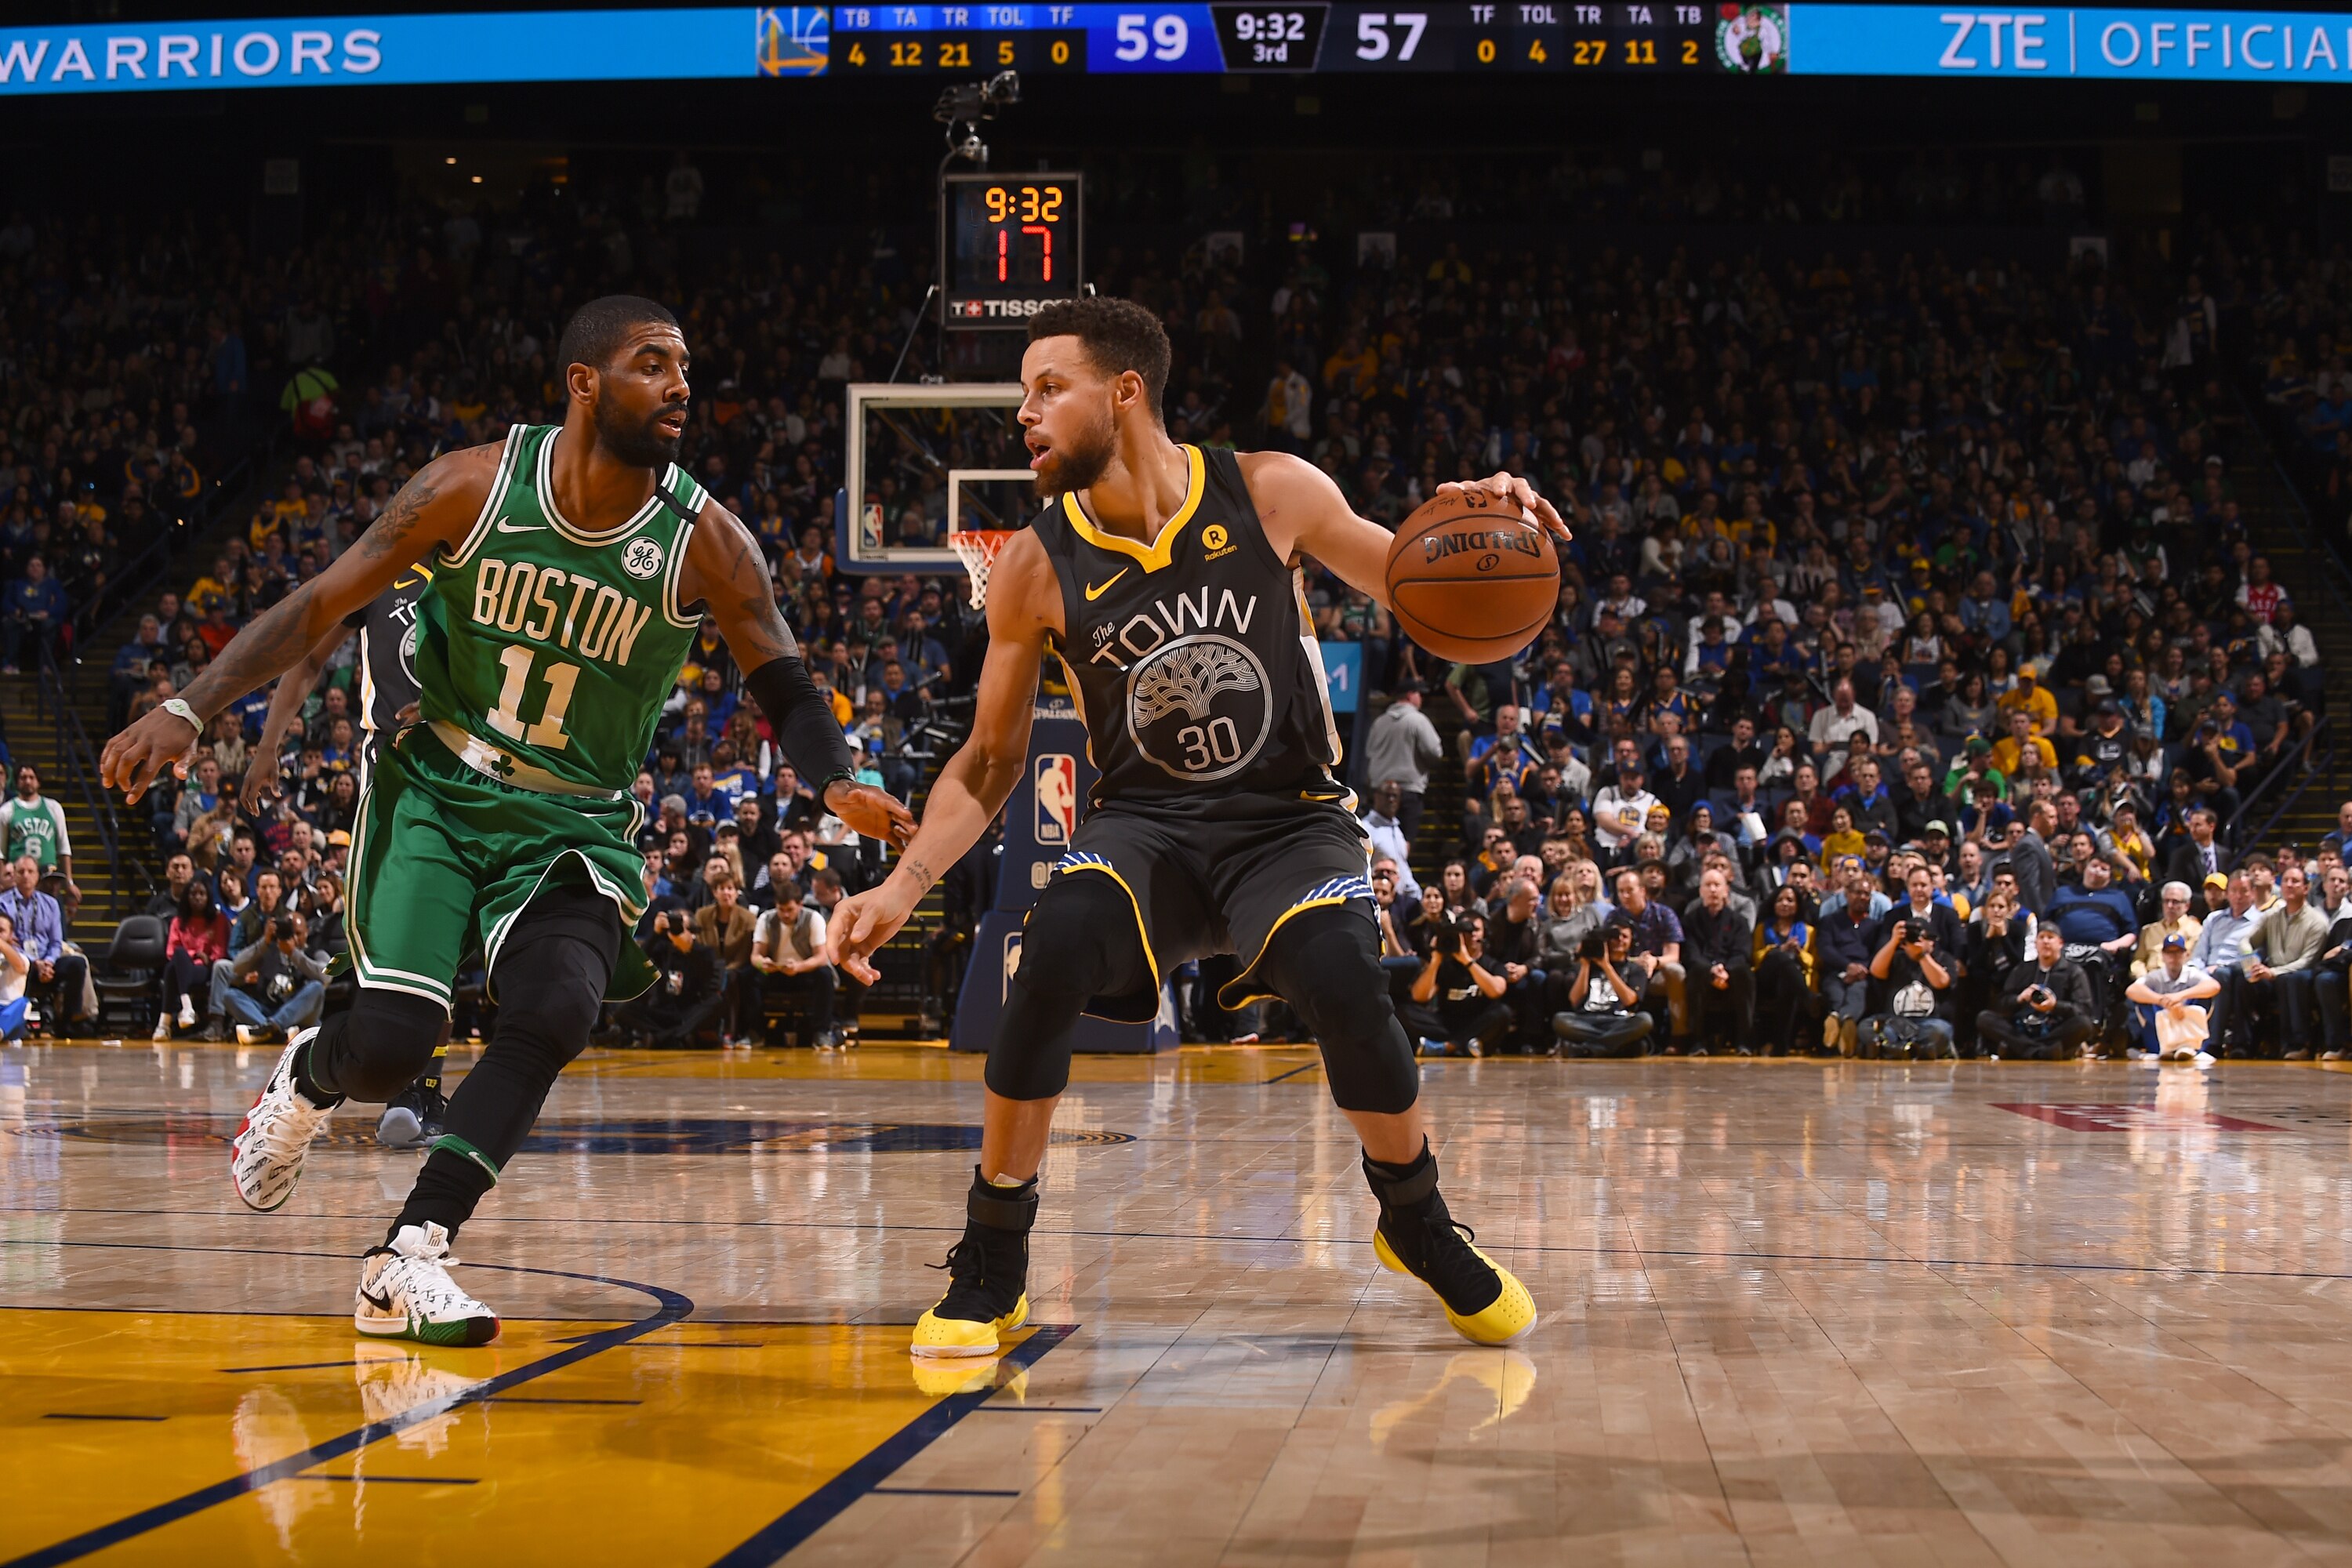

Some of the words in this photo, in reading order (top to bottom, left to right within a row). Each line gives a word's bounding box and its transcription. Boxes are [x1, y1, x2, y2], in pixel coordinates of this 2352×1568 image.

[845, 9, 869, 27] TB
[895, 8, 918, 27] TA
[943, 8, 969, 26] TR
[989, 7, 1023, 26] TOL
[1051, 6, 1073, 24] TF
[1236, 13, 1305, 41] 9:32
[1471, 5, 1495, 24] TF
[1520, 5, 1556, 24] TOL
[1575, 5, 1602, 24] TR
[1627, 5, 1653, 24] TA
[1675, 5, 1702, 24] TB
[848, 42, 866, 66] 4
[890, 42, 922, 66] 12
[938, 42, 971, 67] 21
[997, 41, 1014, 64] 5
[1051, 41, 1069, 64] 0
[1114, 13, 1189, 61] 59
[1254, 42, 1288, 62] 3rd
[1356, 13, 1428, 61] 57
[1477, 39, 1496, 63] 0
[1528, 39, 1548, 63] 4
[1573, 40, 1606, 64] 27
[1624, 40, 1657, 64] 11
[1681, 40, 1698, 64] 2
[1939, 13, 2048, 69] ZTE
[2101, 22, 2352, 71] OFFICIA
[0, 30, 382, 82] WARRIORS
[985, 187, 1063, 223] 9:32
[997, 225, 1052, 282] 17
[1203, 544, 1238, 562] Rakuten
[1208, 530, 1223, 545] R
[1423, 531, 1541, 564] SPALDING
[472, 558, 652, 666] BOSTON
[1090, 586, 1257, 672] TOWN
[1091, 621, 1116, 648] The
[485, 644, 581, 751] 11
[1177, 716, 1242, 771] 30
